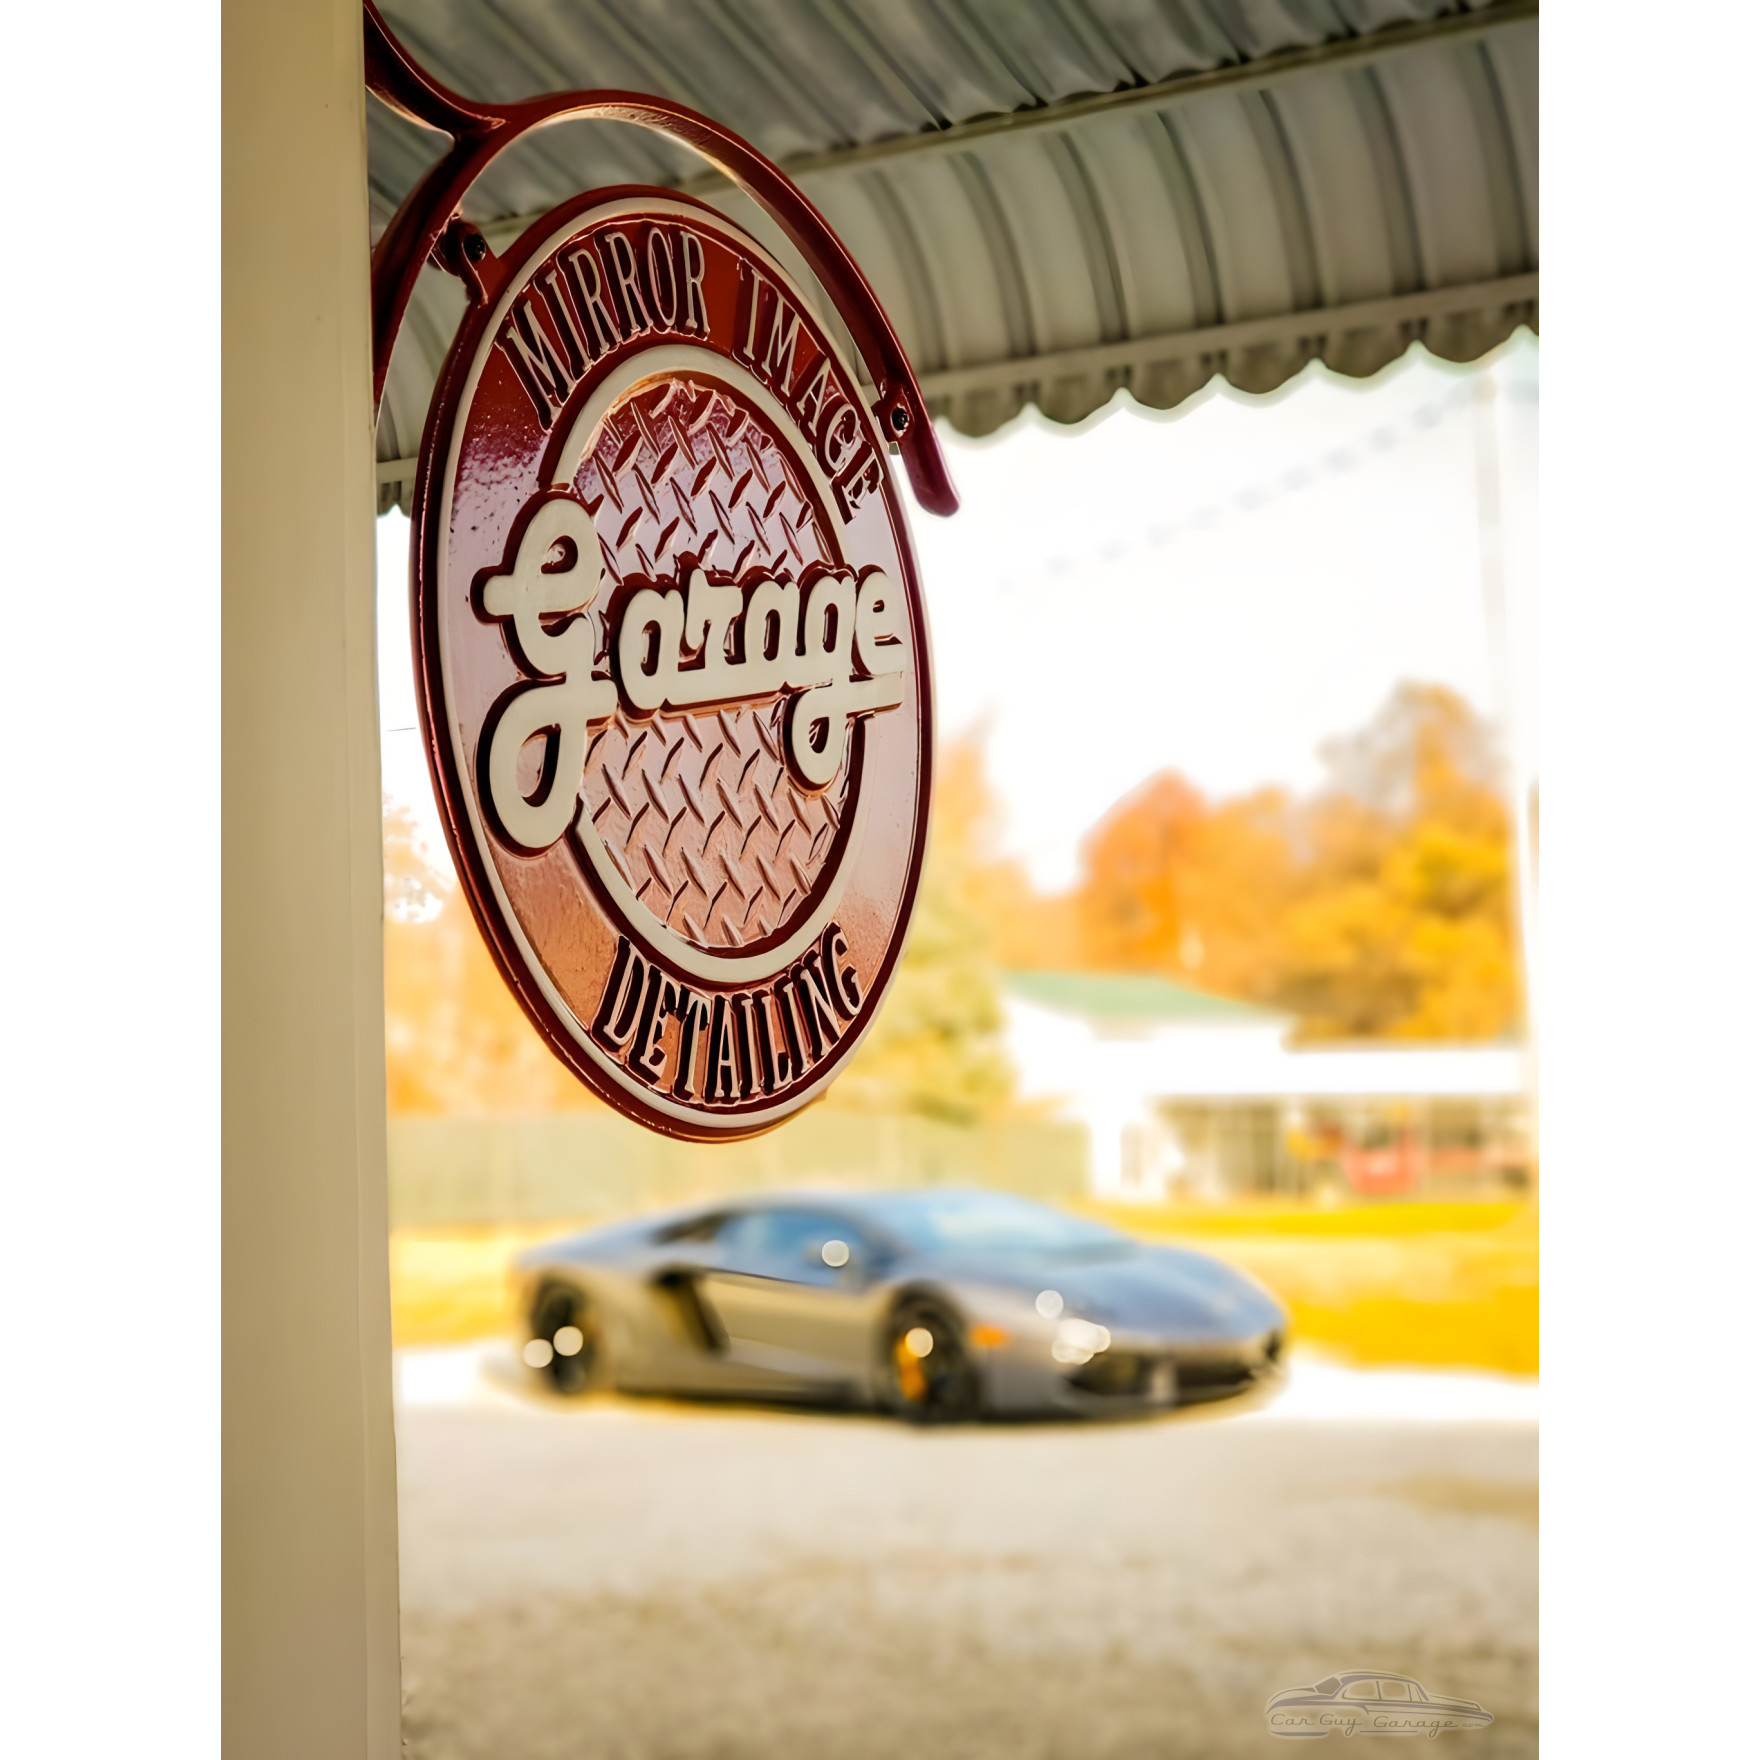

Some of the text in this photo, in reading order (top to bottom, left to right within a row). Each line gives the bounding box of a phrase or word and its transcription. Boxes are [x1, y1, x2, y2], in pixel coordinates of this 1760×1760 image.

[502, 229, 883, 524] MIRROR IMAGE
[482, 497, 905, 849] Garage
[597, 926, 863, 1104] DETAILING
